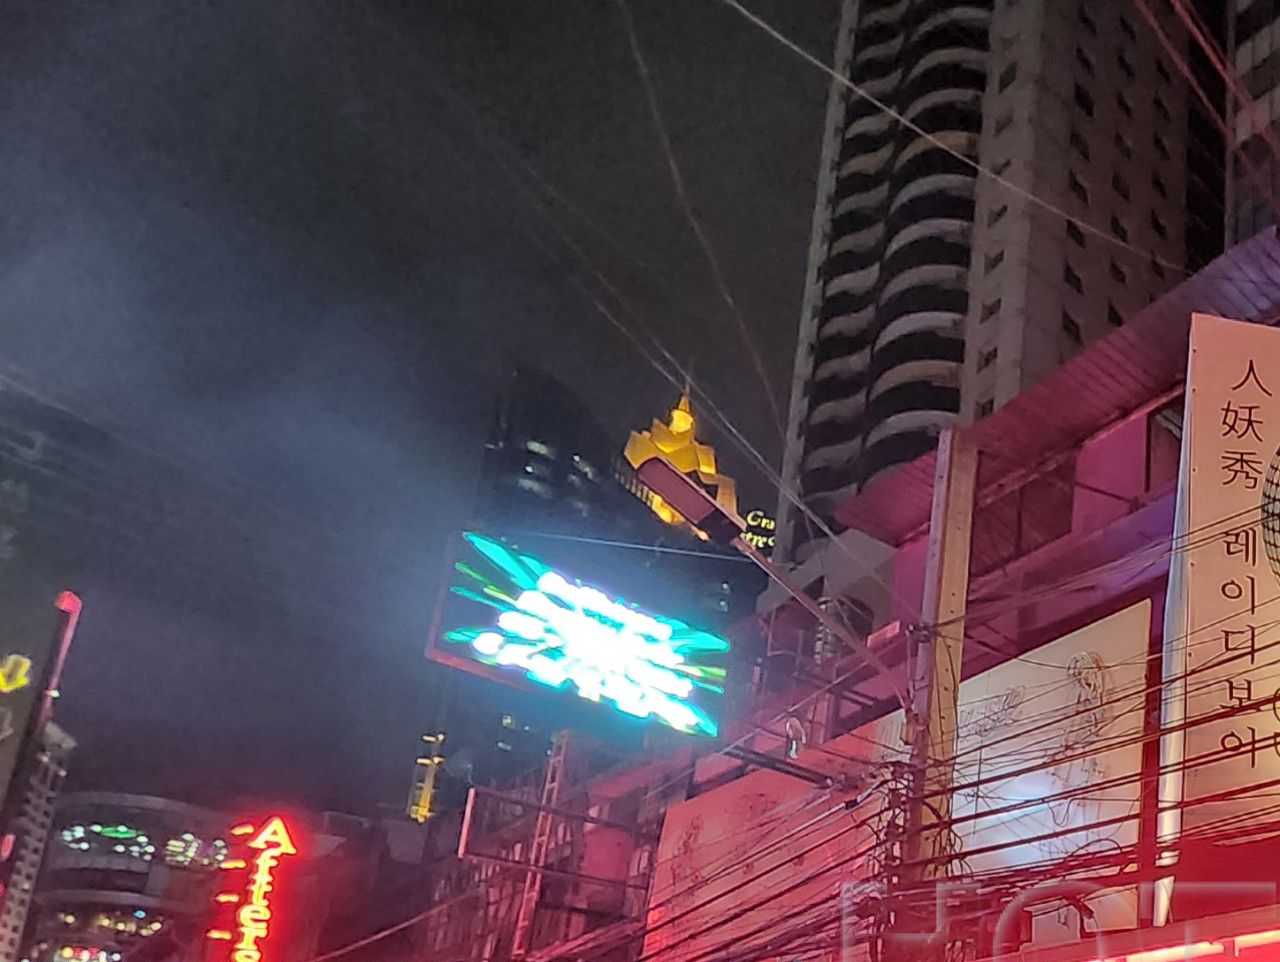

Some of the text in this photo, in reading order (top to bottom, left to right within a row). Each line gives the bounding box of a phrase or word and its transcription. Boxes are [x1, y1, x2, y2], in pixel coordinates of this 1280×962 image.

[1220, 358, 1273, 490] 人妖秀
[1218, 526, 1258, 769] 레이디보이
